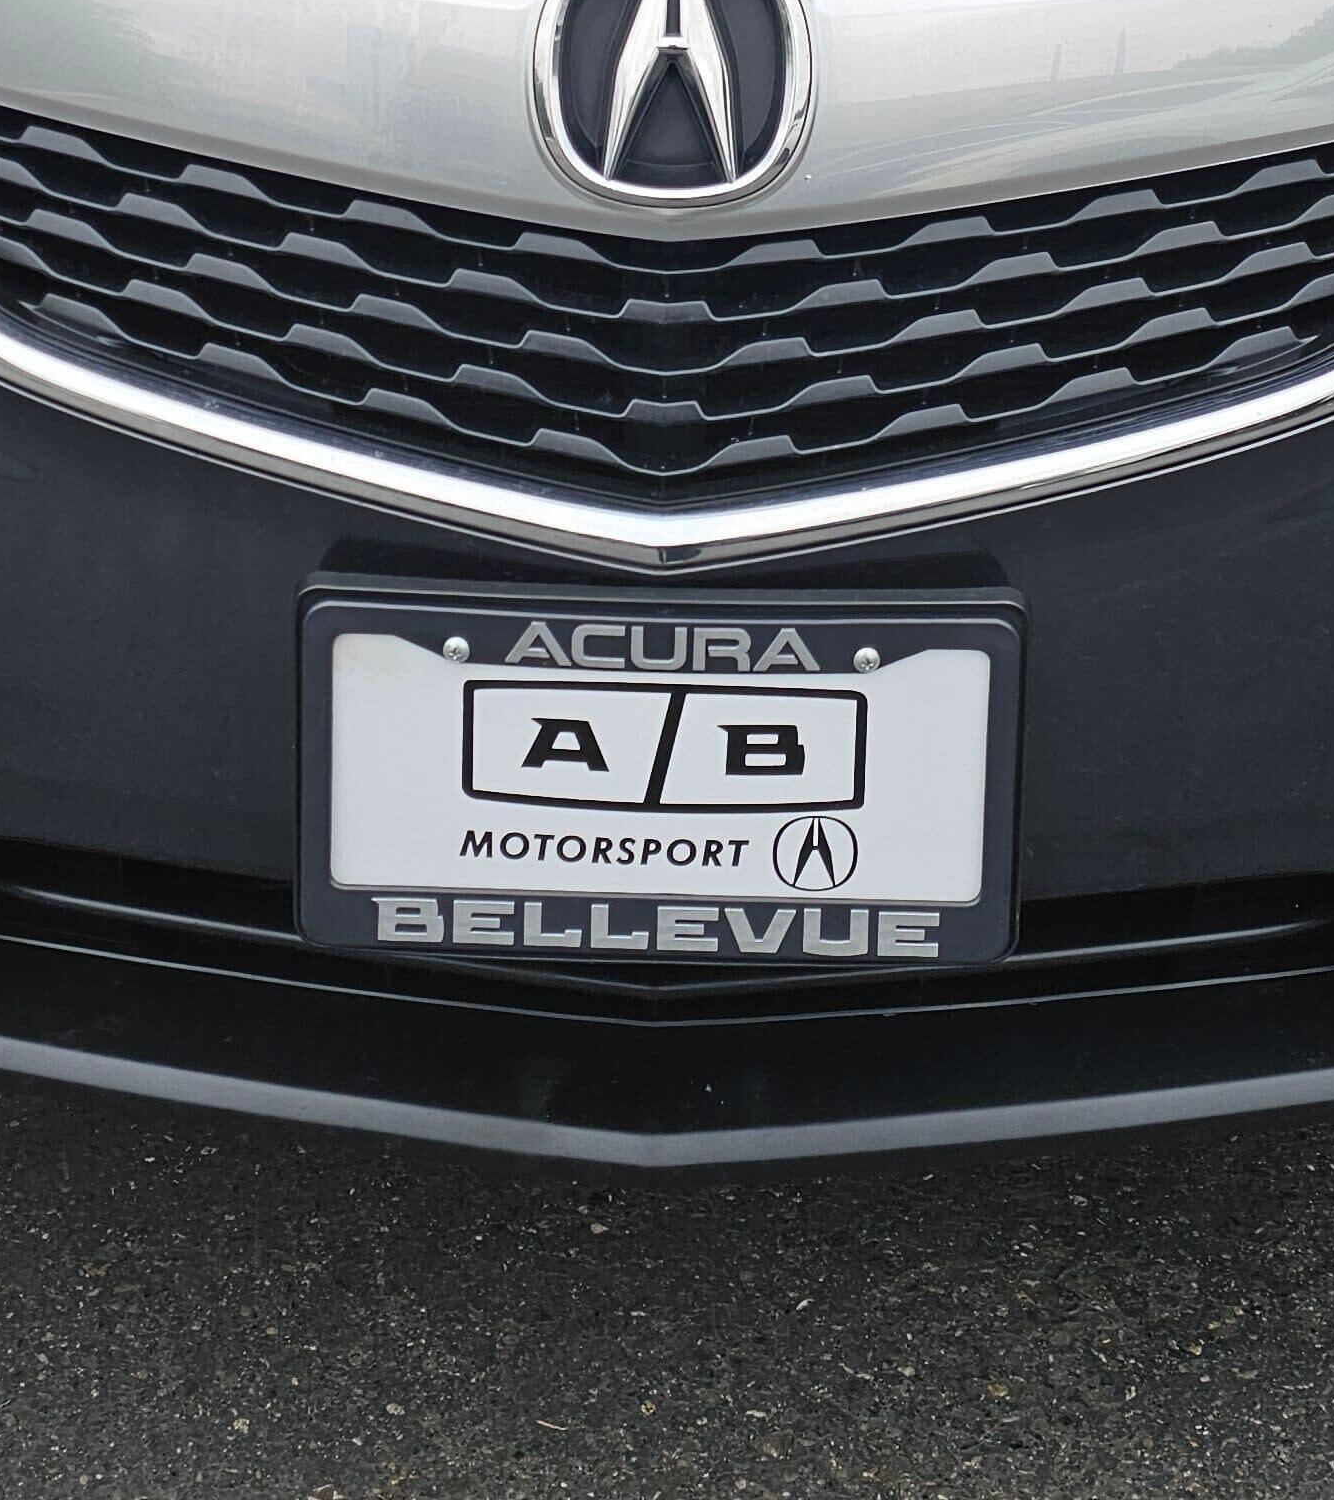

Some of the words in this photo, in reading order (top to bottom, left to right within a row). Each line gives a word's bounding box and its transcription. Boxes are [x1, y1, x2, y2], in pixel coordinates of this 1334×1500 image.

[504, 620, 822, 673] ACURA
[521, 716, 610, 772] A
[717, 723, 805, 776] B
[459, 829, 751, 868] MOTORSPORT
[370, 896, 941, 959] BELLEVUE
